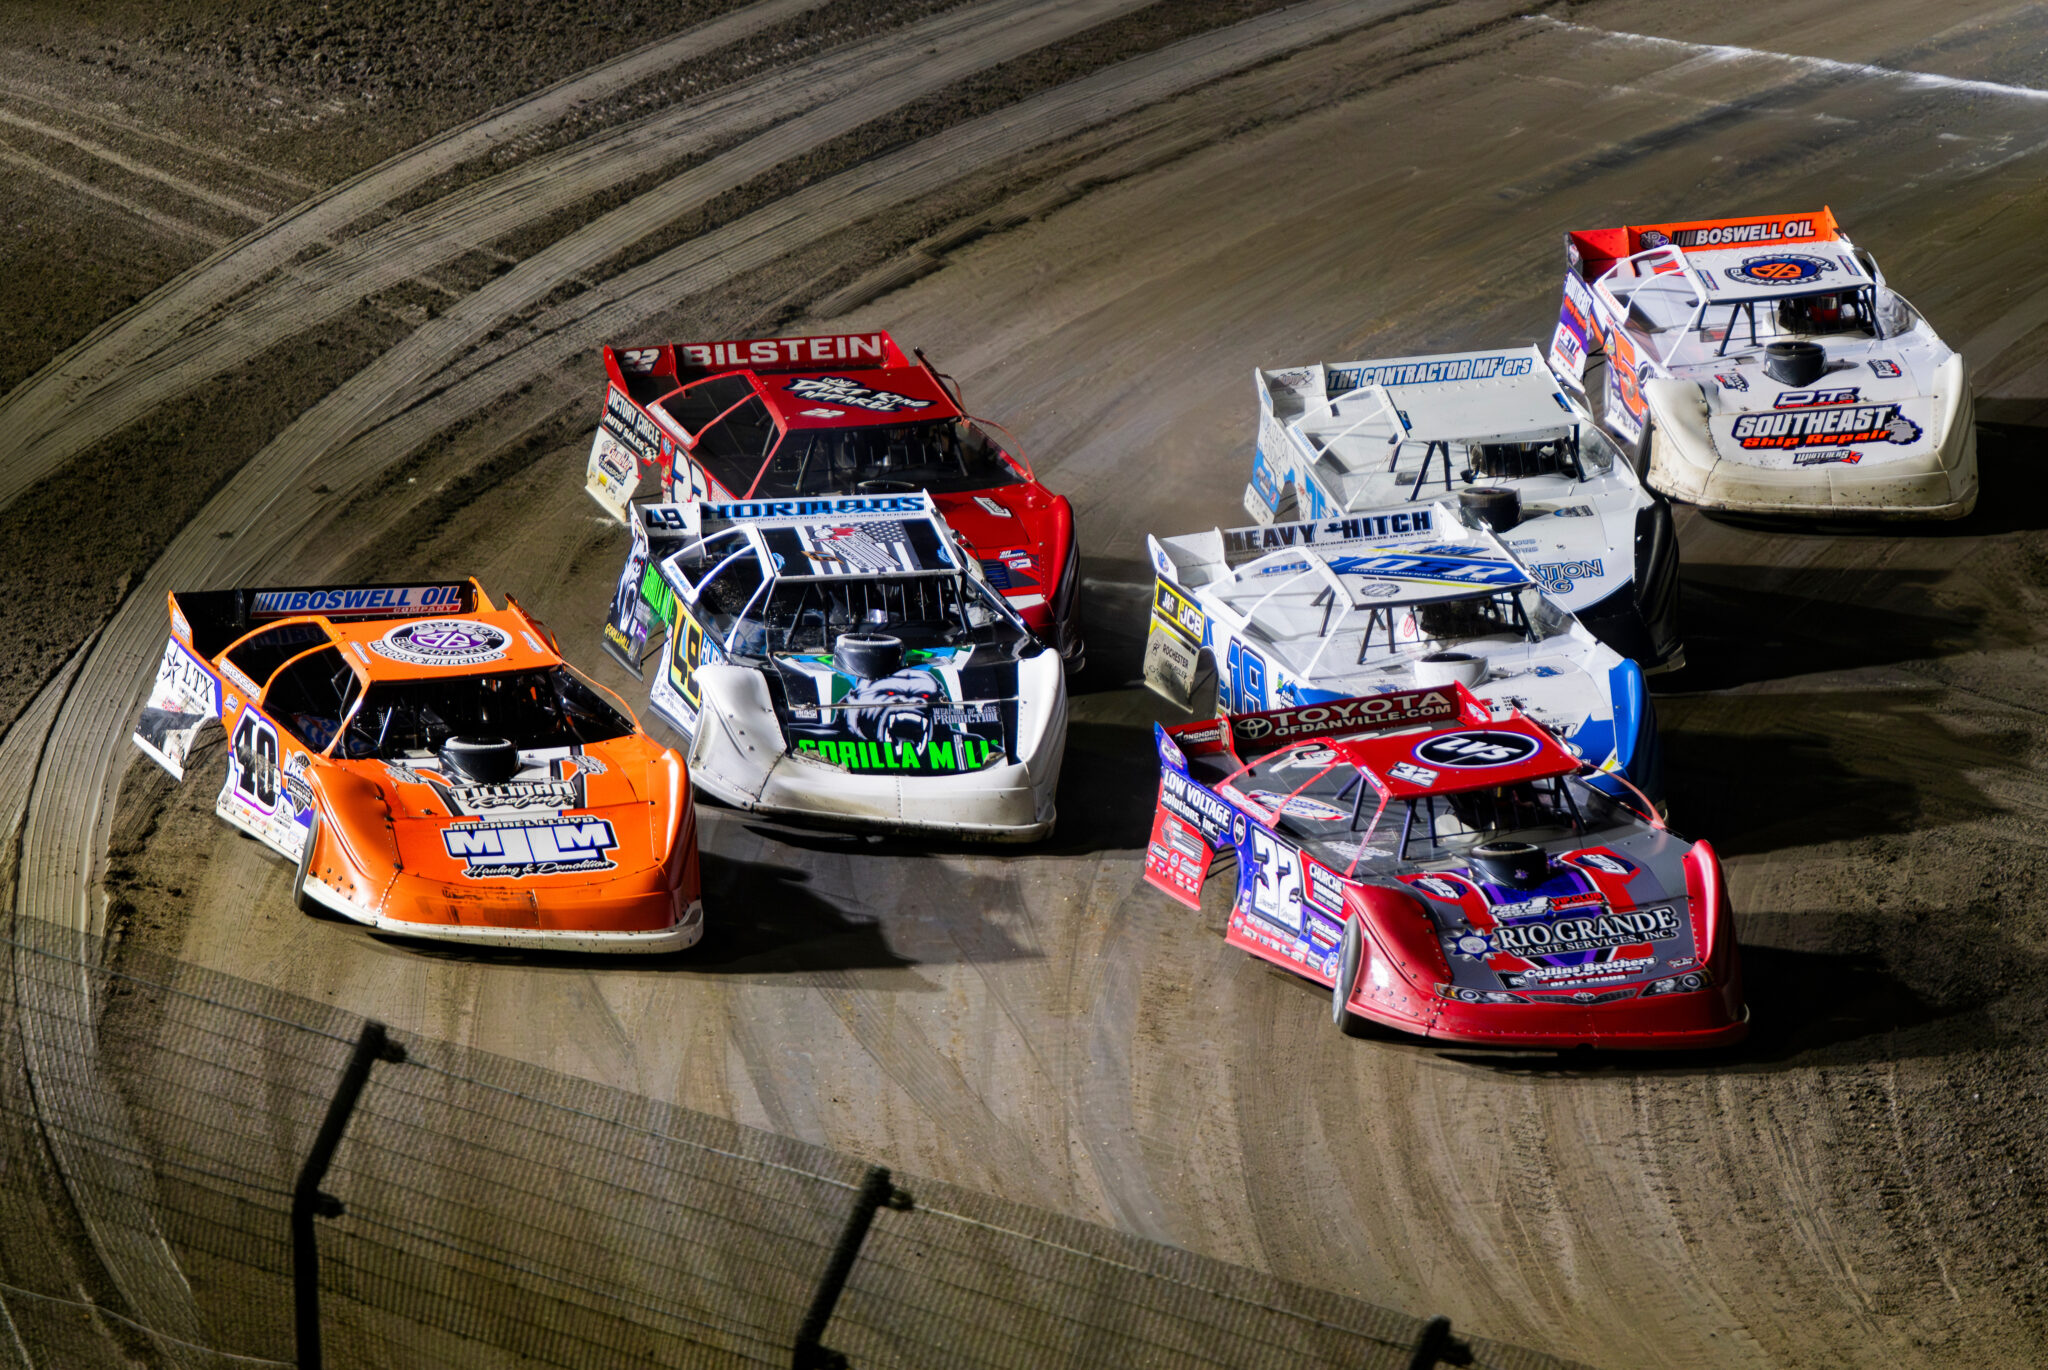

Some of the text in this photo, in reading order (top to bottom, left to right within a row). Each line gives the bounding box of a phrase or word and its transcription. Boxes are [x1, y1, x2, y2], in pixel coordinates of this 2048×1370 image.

[1696, 220, 1815, 245] BOSWELL OIL
[684, 336, 881, 366] BILSTEIN
[1329, 369, 1359, 390] THE
[1362, 360, 1470, 386] CONTRACTOR
[1473, 357, 1532, 378] MF'ers
[604, 412, 644, 451] AUTO SALES
[608, 388, 636, 425] VICTORY
[636, 413, 660, 447] CIRCLE
[1736, 407, 1892, 438] SOUTHEAST
[1743, 430, 1890, 449] Ship Repair
[646, 508, 687, 529] 49
[1224, 511, 1433, 550] HEAVY HITCH
[289, 586, 460, 611] BOSWELL OIL
[393, 605, 453, 613] COMPANY
[1180, 605, 1202, 637] JCB
[674, 614, 701, 700] 49
[1163, 643, 1188, 669] ROCHESTER
[182, 660, 213, 702] LTX
[1227, 635, 1270, 716] 19
[1270, 692, 1450, 727] TOYOTA
[1274, 706, 1451, 736] OFDANVILLE.COM
[235, 714, 278, 807] 40
[1391, 762, 1437, 786] 32
[455, 783, 574, 801] TILLMAN
[468, 795, 563, 809] Roofing
[1163, 768, 1186, 796] LOW
[1186, 783, 1231, 827] VOLTAGE
[468, 860, 610, 876] Hauling & Demolition
[1253, 827, 1302, 931] 32
[1498, 908, 1677, 949] RIO GRANDE
[1511, 929, 1676, 956] WASTE SERVICES, INC.
[1524, 963, 1582, 978] Collins
[1584, 956, 1655, 972] Brothers
